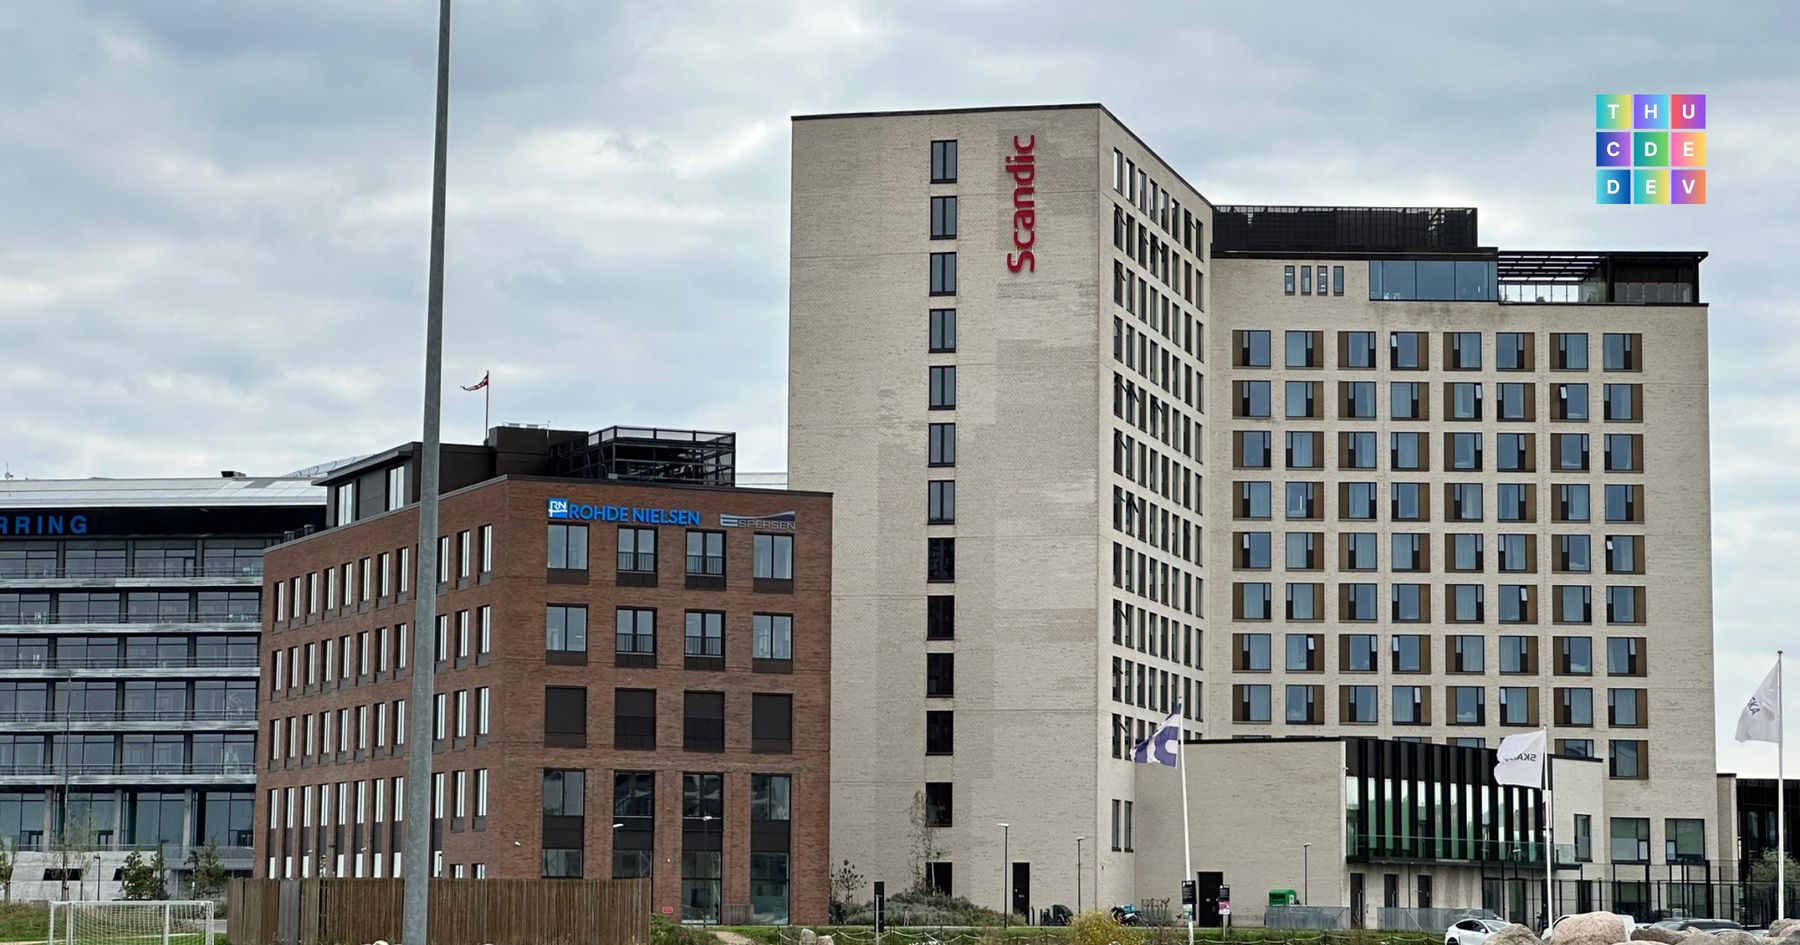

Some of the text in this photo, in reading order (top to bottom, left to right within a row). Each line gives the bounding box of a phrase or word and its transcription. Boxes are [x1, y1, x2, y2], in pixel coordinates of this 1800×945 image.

[1004, 134, 1035, 273] Scandic
[549, 500, 701, 526] RN ROHDE NIELSEN
[720, 514, 796, 530] ESPERSEN
